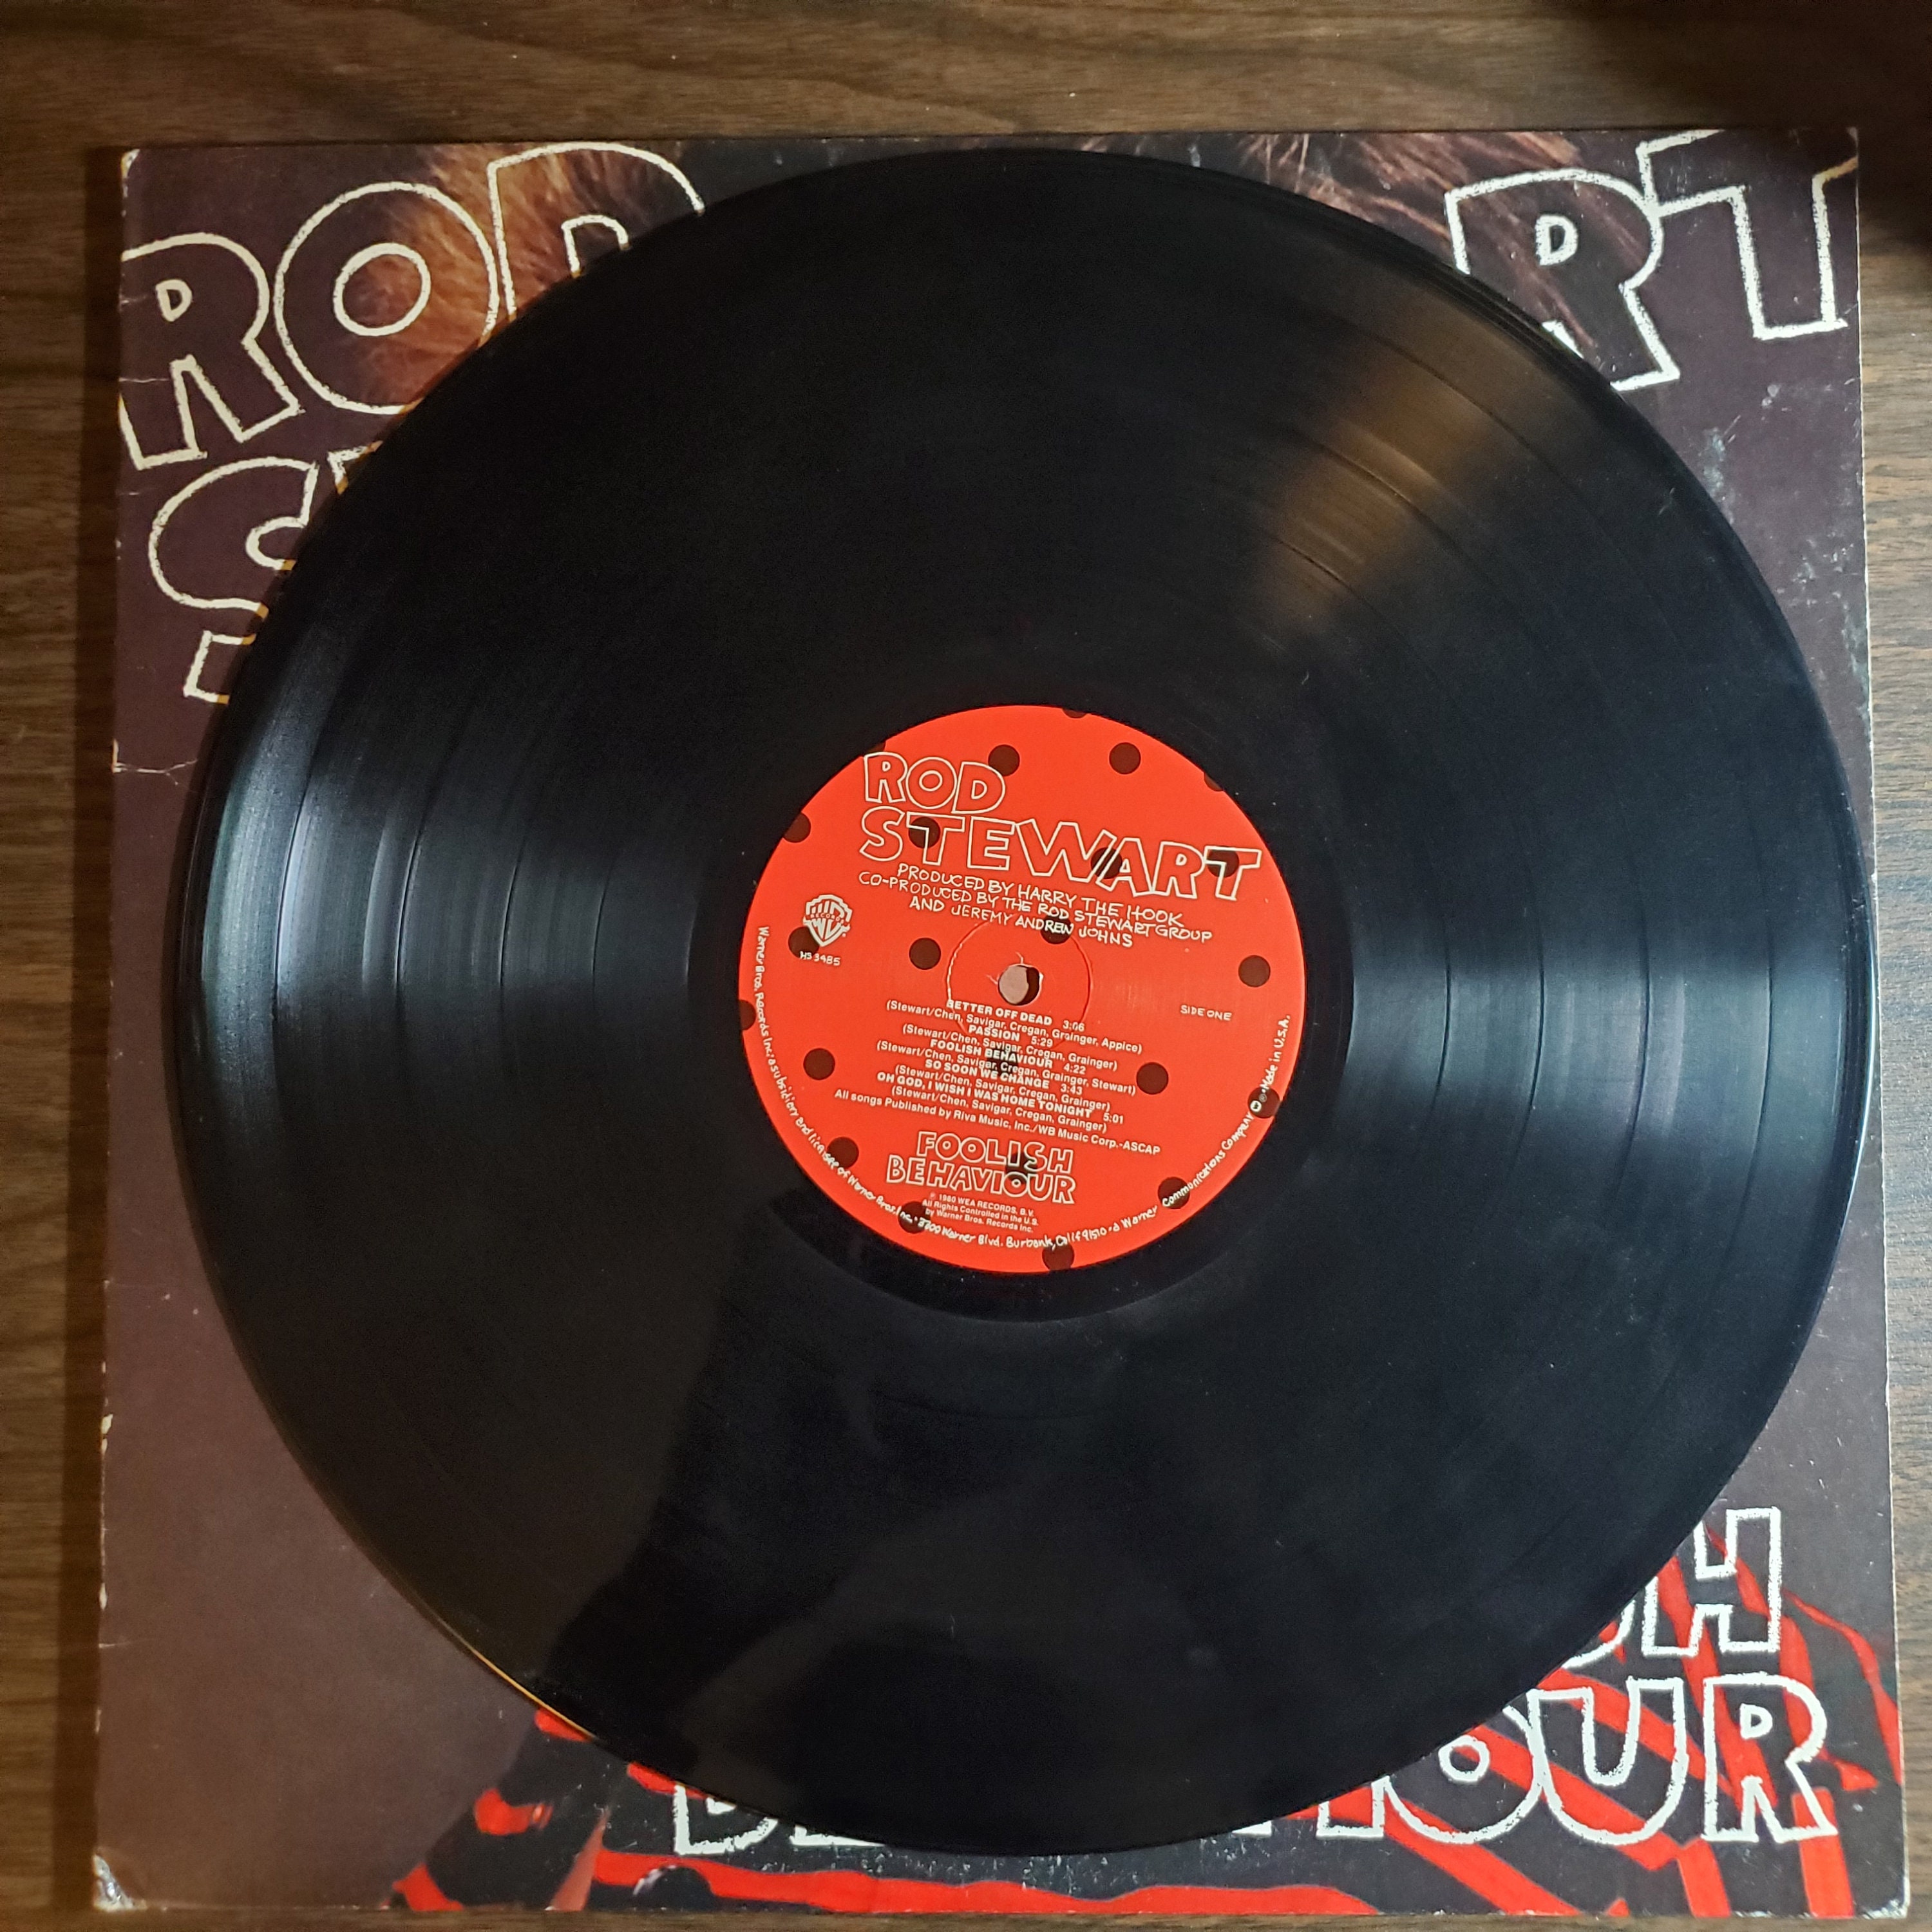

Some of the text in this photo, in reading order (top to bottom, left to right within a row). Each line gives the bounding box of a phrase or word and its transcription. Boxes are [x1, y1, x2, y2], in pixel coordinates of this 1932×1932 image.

[864, 752, 1006, 814] ROD
[859, 806, 1262, 900] STEWART
[858, 871, 1212, 943] CO-PRODUCED BY THE ROD STEWART GROUP
[894, 863, 1184, 927] PRODUCED BY HARRY THE HOOK
[909, 896, 1133, 947] AND JEREMY ANDREW JOHNS
[755, 926, 770, 965] Warner
[800, 951, 840, 966] HS 3485
[753, 965, 765, 992] Bros.
[755, 992, 770, 1037] Records
[887, 1000, 1142, 1054] (Stewart/Chen, Savigar, Cregan, Grainger, Appice)
[946, 998, 1084, 1032] BETTER OFF DEAD 3:06
[1180, 1005, 1233, 1021] SIDE ONE
[903, 1024, 1117, 1071] (Stewart/Chen, Savigar, Cregan, Grainger)
[969, 1024, 1053, 1048] PASSION 5:29
[1273, 1015, 1291, 1048] U.S.A.
[876, 1041, 1136, 1096] (Stewart/Chen, Savigar, Cregan, Grainger, Stewart)
[930, 1039, 1086, 1075] FOOLISH BEHAVIOUR 4:22
[1268, 1051, 1282, 1063] in
[895, 1065, 1110, 1112] (Stewart/Chen, Savigar, Cregan, Grainger)
[925, 1059, 1083, 1095] SO SOON WE CHANGE 3:43
[1260, 1065, 1278, 1090] Made
[877, 1072, 1123, 1124] OH GOD, I WISH I WAS HOME TONIGHT 5:01
[891, 1086, 1106, 1133] (Stewart/Chen, Savigar, Cregan, Grainger)
[795, 1117, 814, 1135] and
[835, 1089, 1160, 1155] All songs Published by Riva Music, Inc./WB Music Corp.-ASCAP
[916, 1131, 1074, 1172] FOOLISH
[837, 1167, 851, 1178] of
[886, 1154, 1077, 1205] BEHAVIOUR
[1162, 1150, 1226, 1207] Communications
[925, 1208, 1032, 1233] by Warner Bros. Records Inc.
[934, 1201, 958, 1213] Rights
[960, 1206, 1000, 1220] Controlled
[1024, 1217, 1037, 1226] U.S.
[1121, 1206, 1158, 1228] Warner
[942, 1226, 976, 1243] Warner
[978, 1234, 1004, 1247] Blvd.
[1006, 1235, 1056, 1251] Burbank,
